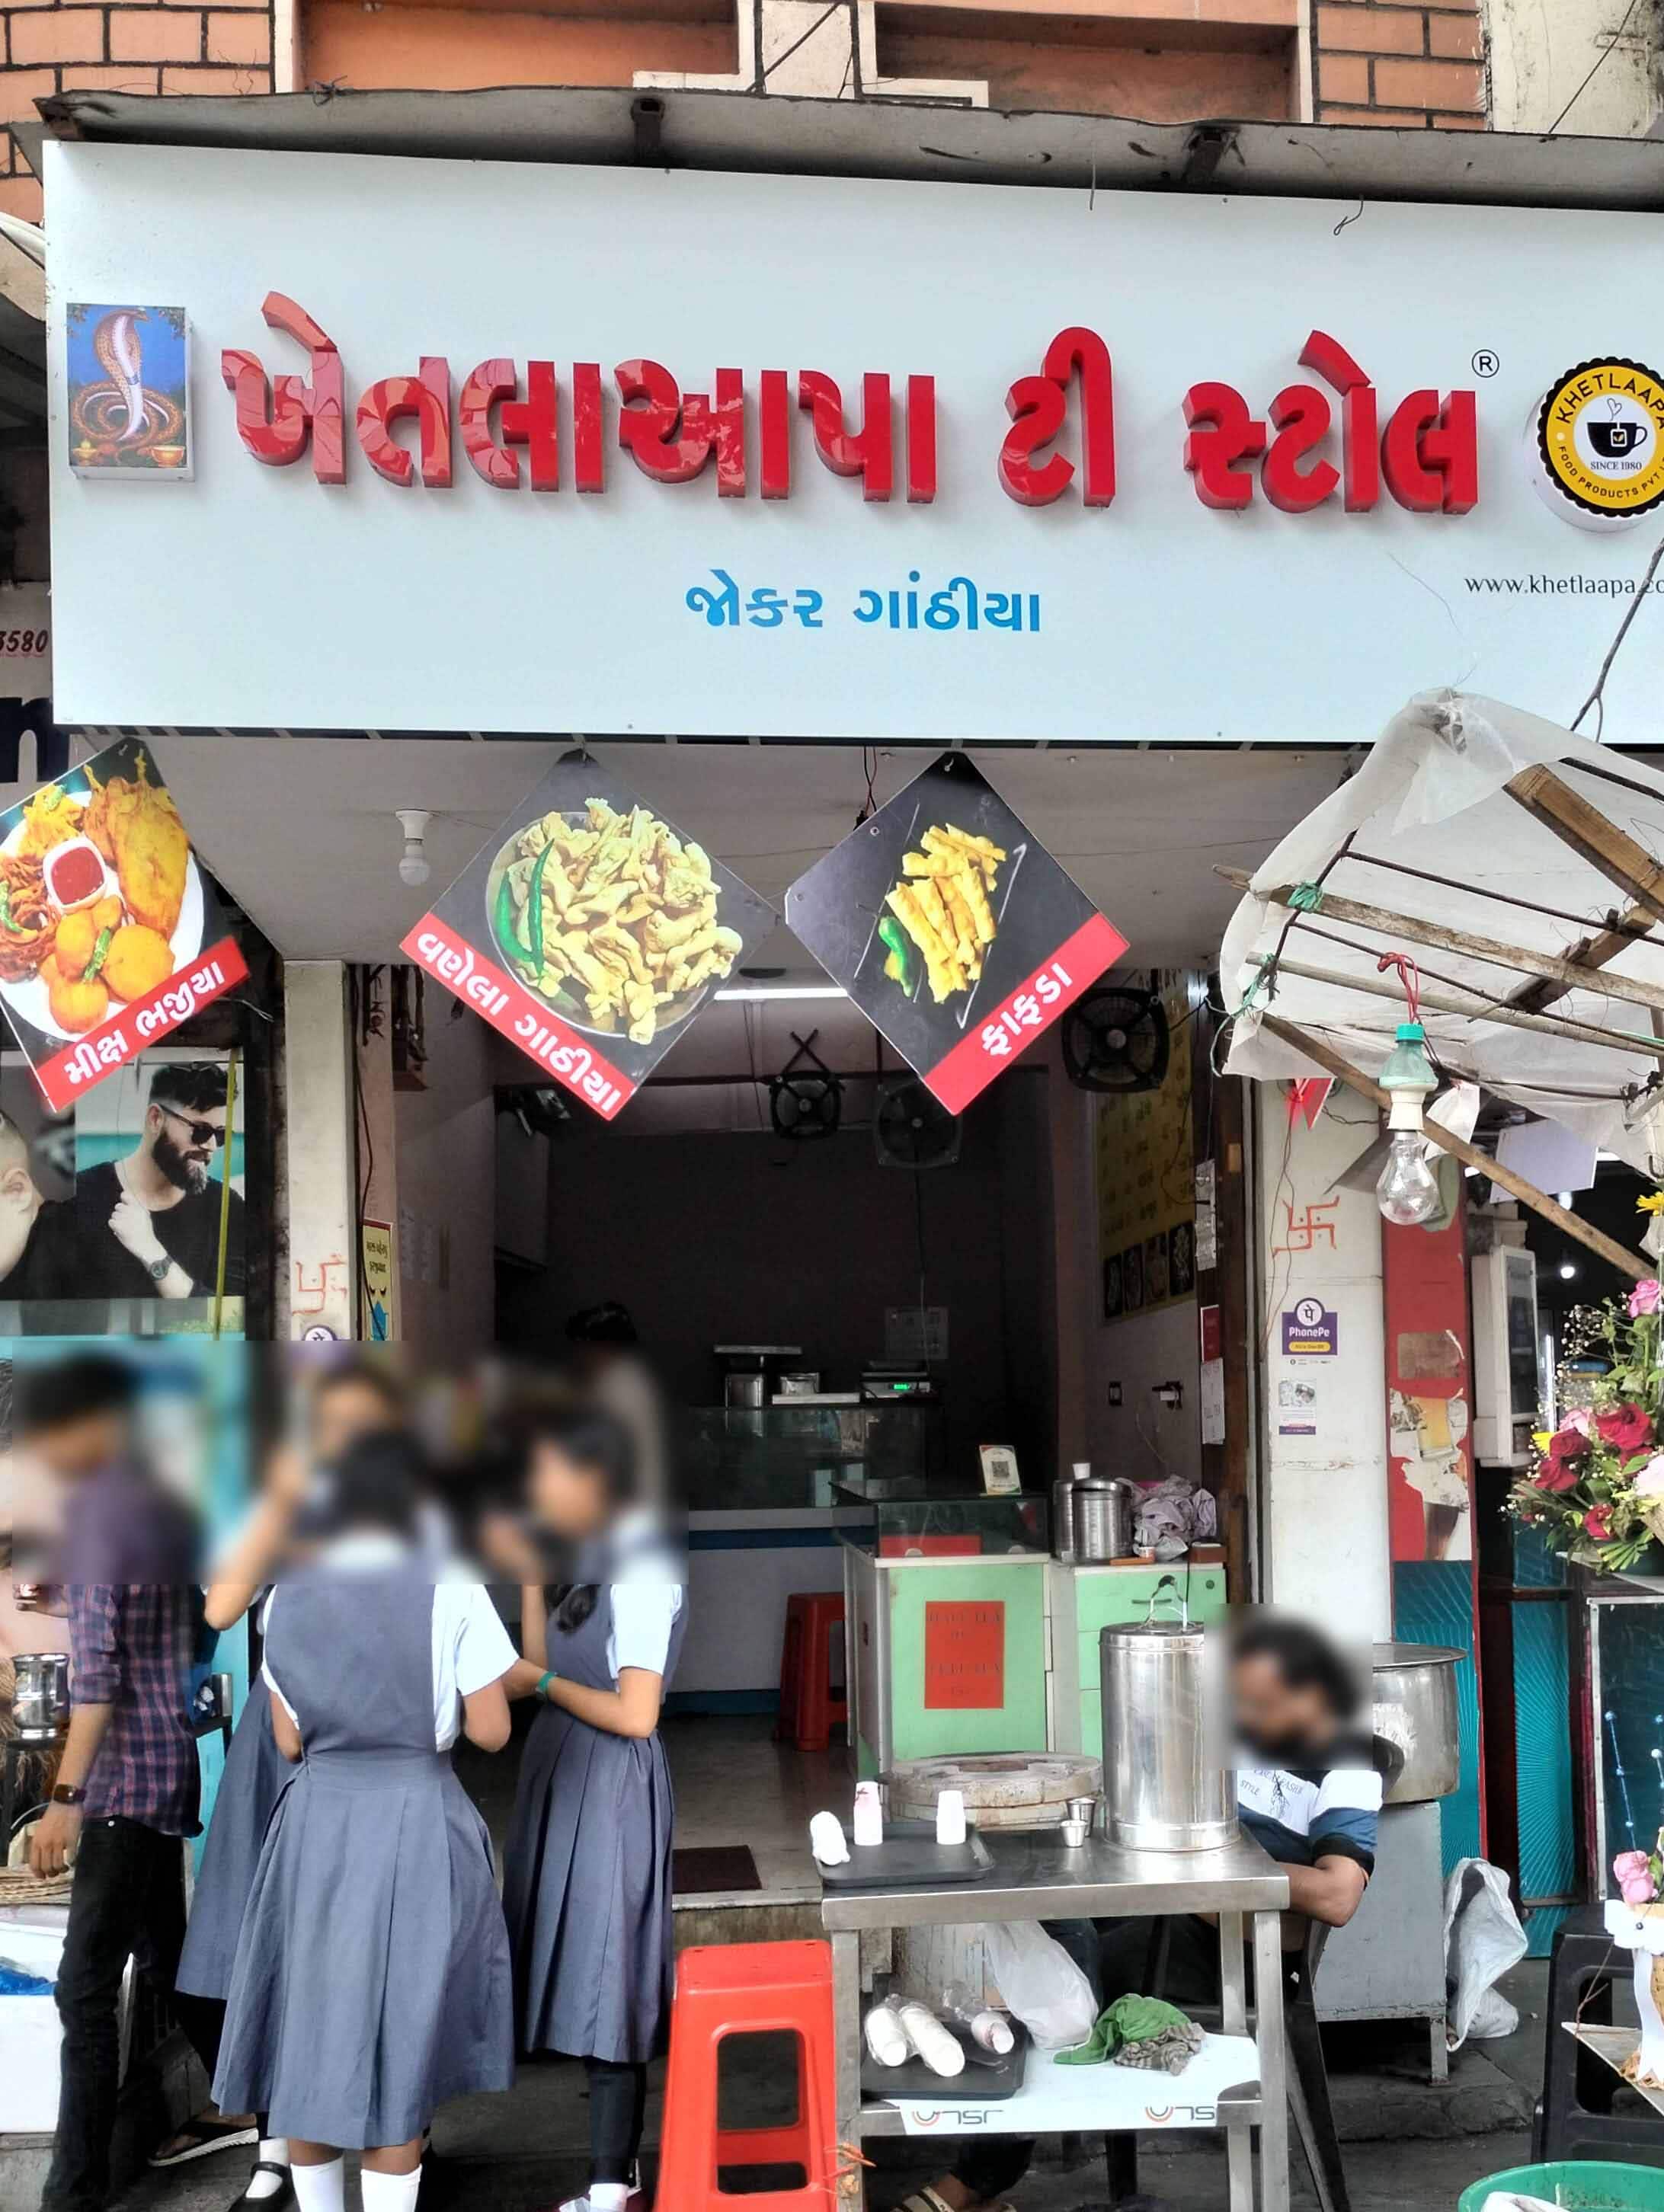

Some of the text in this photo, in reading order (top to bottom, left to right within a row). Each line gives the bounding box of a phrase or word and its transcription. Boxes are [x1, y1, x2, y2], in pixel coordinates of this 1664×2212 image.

[221, 292, 1479, 516] ખેતલાઆપા ટી સ્ટોલ
[1559, 446, 1660, 499] FOOD PRODUCTS PVT
[1590, 461, 1643, 470] SINCE 1980
[1464, 574, 1664, 598] www.khetlaapaco
[686, 569, 1040, 632] જોકર ગાંઠીયા
[981, 963, 1073, 1056] ફાફડા
[1288, 1327, 1330, 1338] PhonePe
[1240, 1779, 1260, 1796] STYLE
[1175, 2105, 1216, 2121] SL
